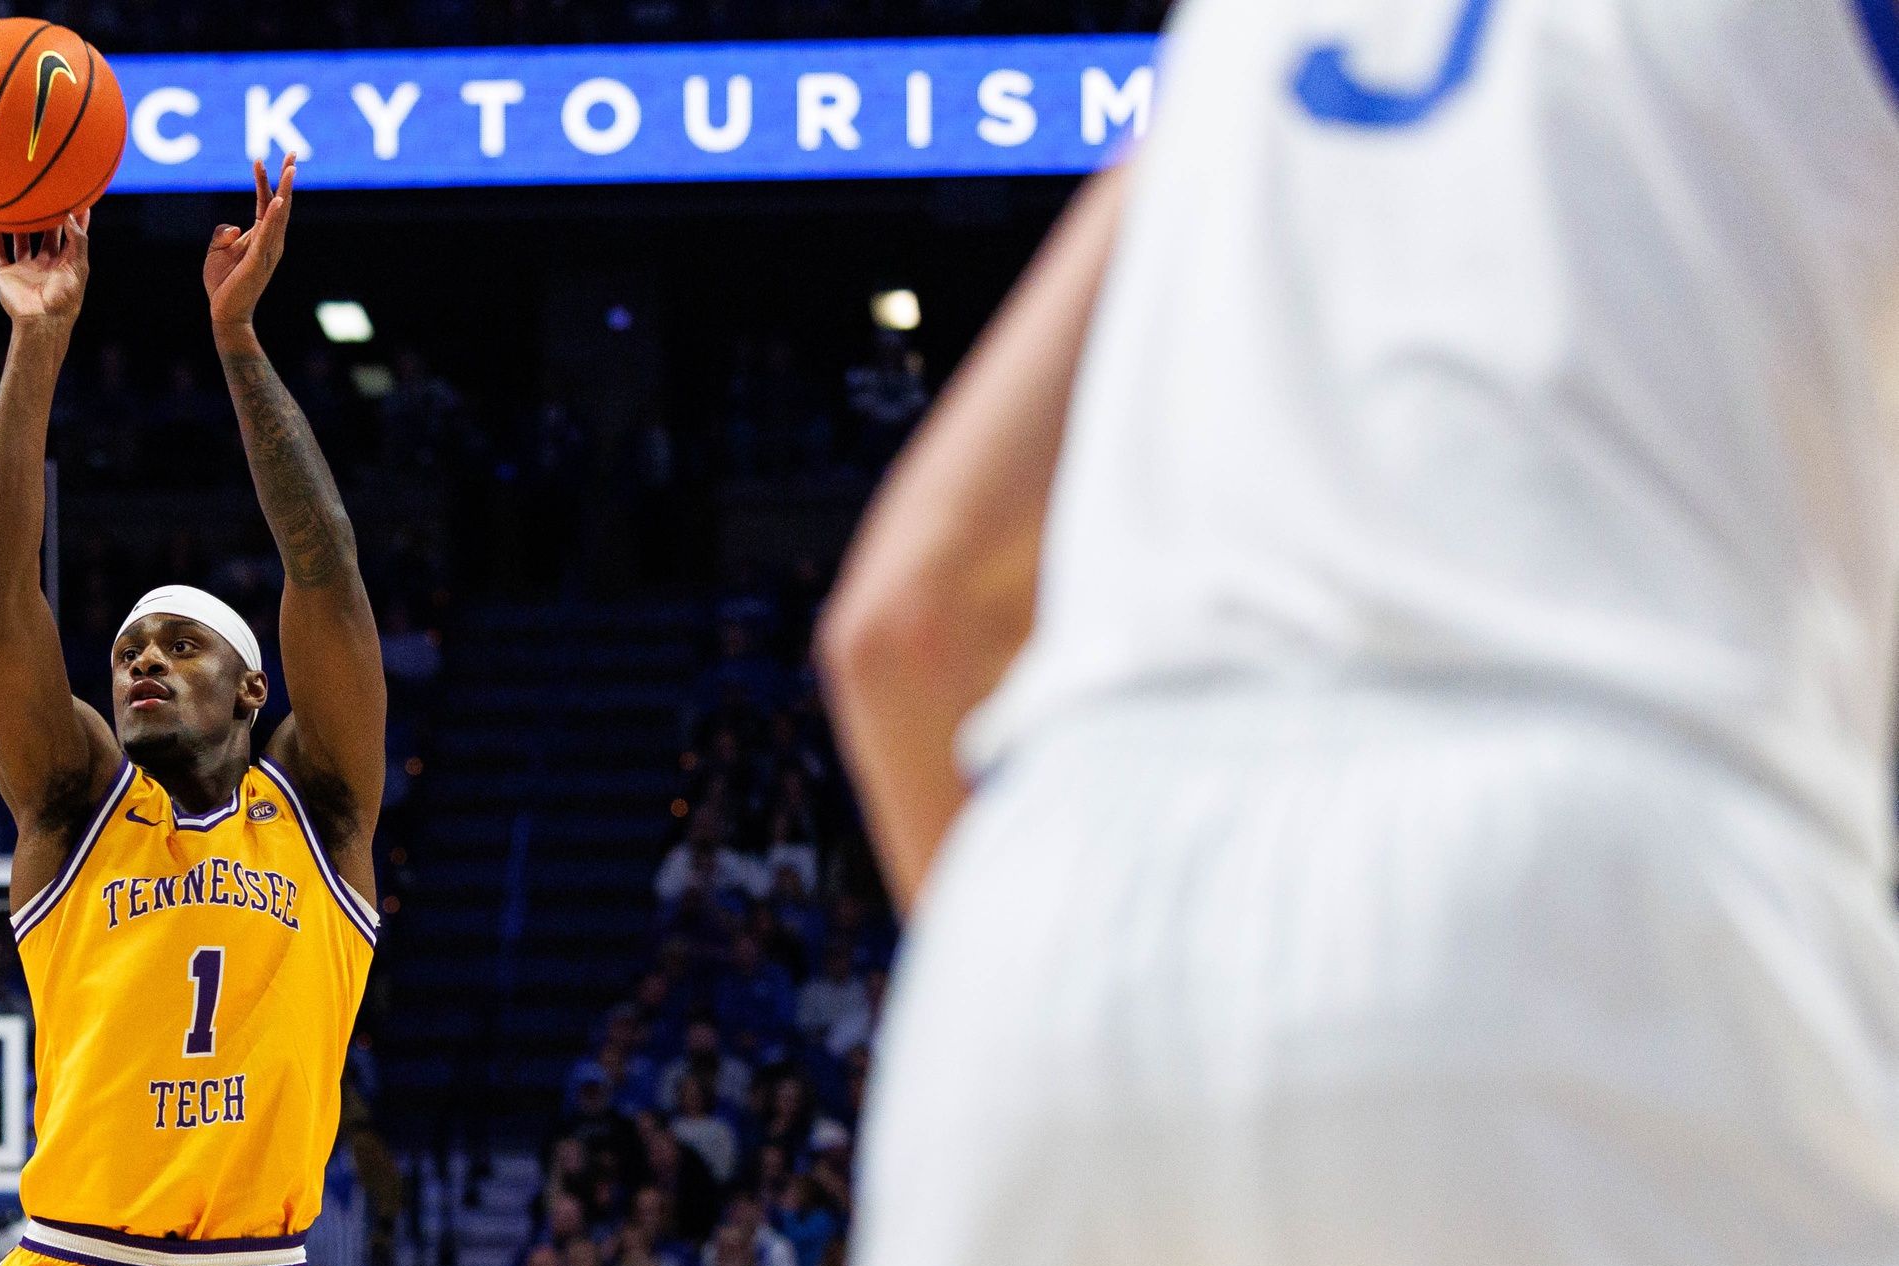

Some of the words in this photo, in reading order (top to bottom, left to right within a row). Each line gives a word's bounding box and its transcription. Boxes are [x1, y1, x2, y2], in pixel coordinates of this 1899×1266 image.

[253, 805, 272, 817] OVC
[102, 856, 301, 932] TENNESSEE
[182, 945, 226, 1059] 1
[149, 1073, 246, 1129] TECH
